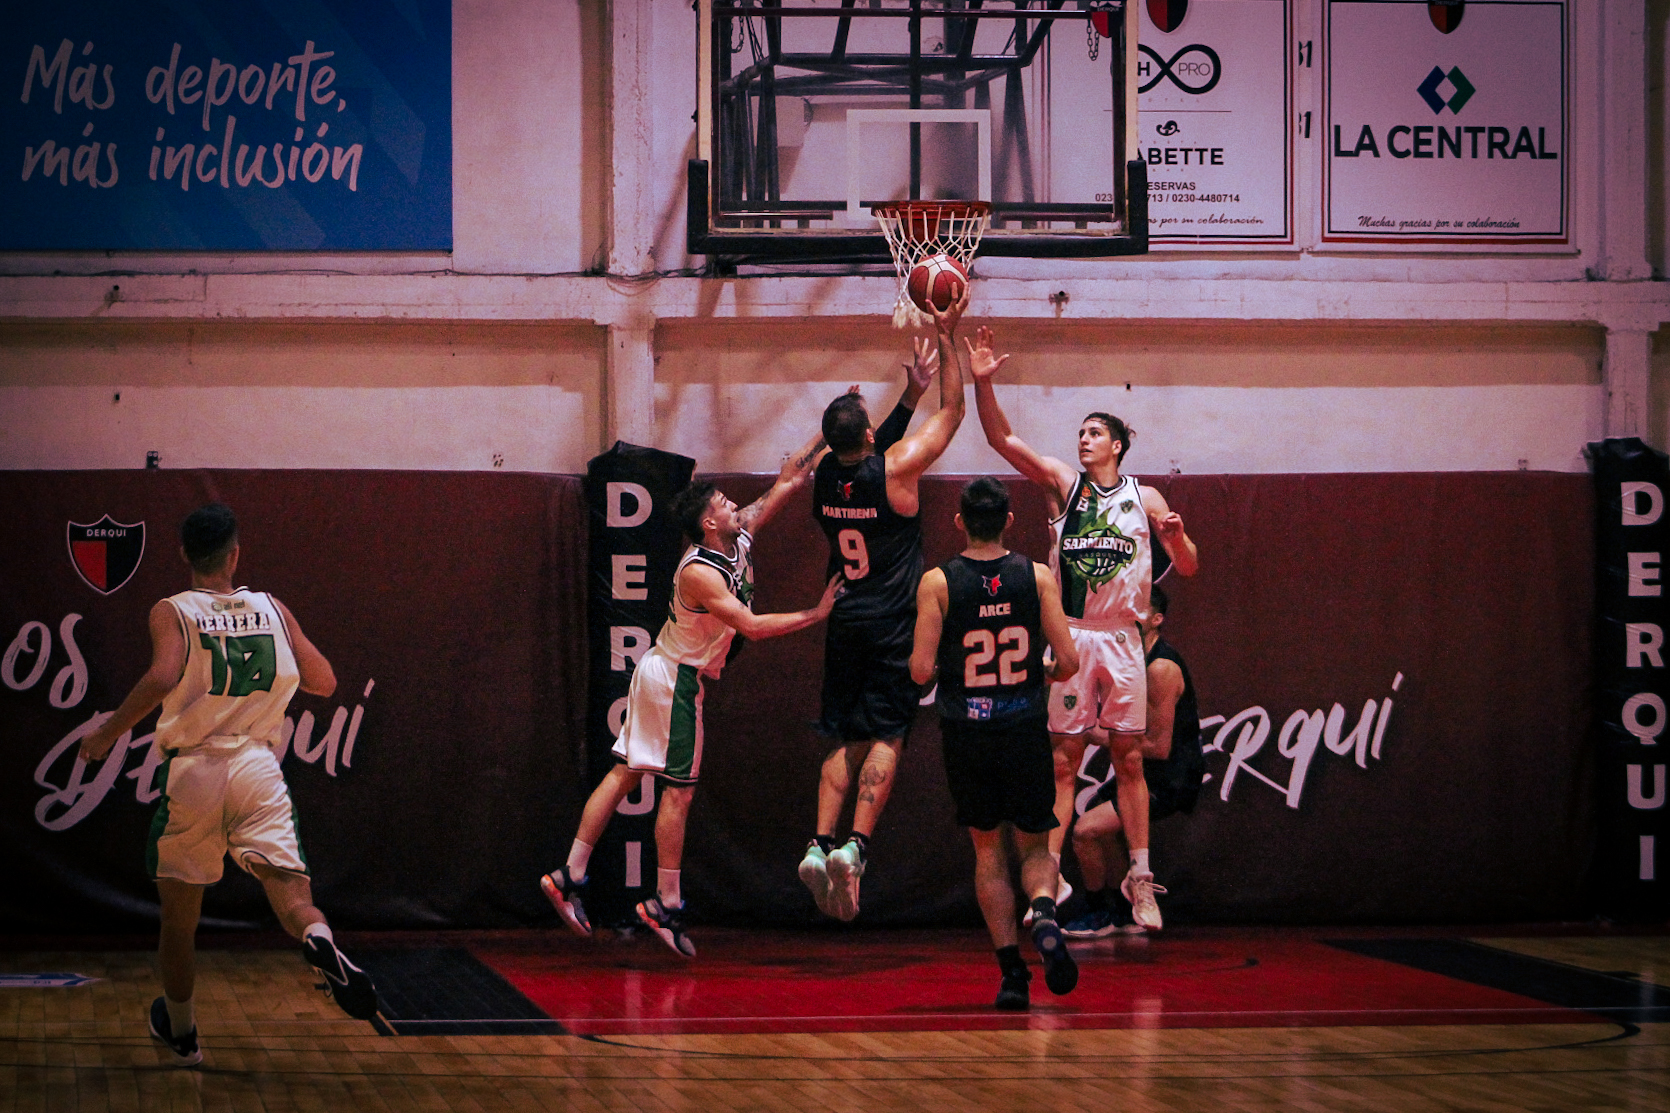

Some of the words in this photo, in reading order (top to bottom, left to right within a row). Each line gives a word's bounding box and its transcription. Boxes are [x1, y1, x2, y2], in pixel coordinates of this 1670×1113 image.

[1178, 62, 1211, 76] PRO
[21, 37, 115, 115] Más
[145, 39, 347, 131] deporte,
[1333, 124, 1381, 158] LA
[1386, 124, 1558, 160] CENTRAL
[21, 121, 119, 189] más
[149, 114, 364, 192] inclusión
[1137, 147, 1224, 165] BETTE
[1146, 181, 1196, 191] ESERVAS
[1172, 193, 1240, 203] 0230-4480714
[1158, 217, 1179, 228] por
[1197, 213, 1264, 225] colaboración
[1357, 215, 1395, 228] Muchas
[1399, 217, 1432, 231] gracias
[1434, 218, 1449, 231] por
[1453, 220, 1463, 228] su
[1466, 216, 1520, 229] colaboración
[86, 528, 127, 538] DERQUI
[838, 528, 870, 581] 9
[1062, 536, 1134, 555] SARMIENTO
[978, 602, 1011, 618] ARCE
[963, 625, 1030, 688] 22
[1620, 481, 1668, 881] DERQUI
